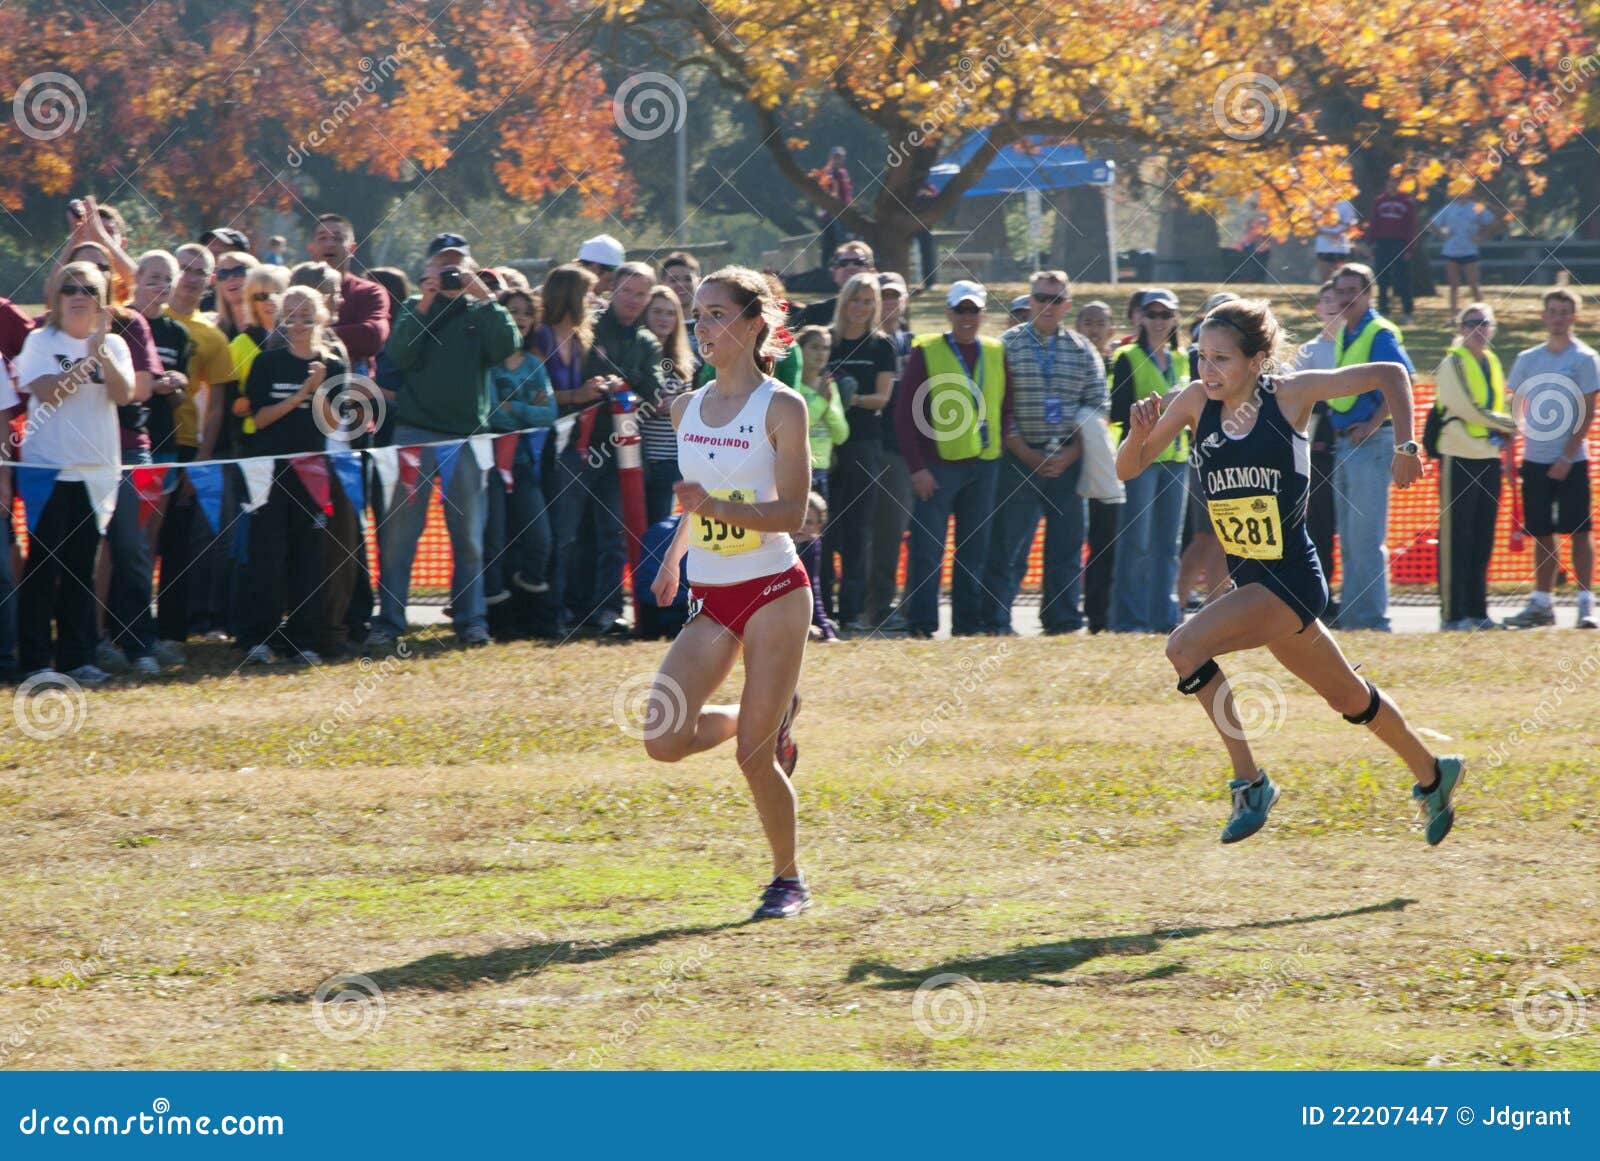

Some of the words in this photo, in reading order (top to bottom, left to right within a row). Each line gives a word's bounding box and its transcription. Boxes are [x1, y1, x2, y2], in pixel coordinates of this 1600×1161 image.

[683, 433, 750, 450] CAMPOLINDO
[1207, 466, 1282, 495] OAKMONT
[1215, 516, 1277, 546] 1281
